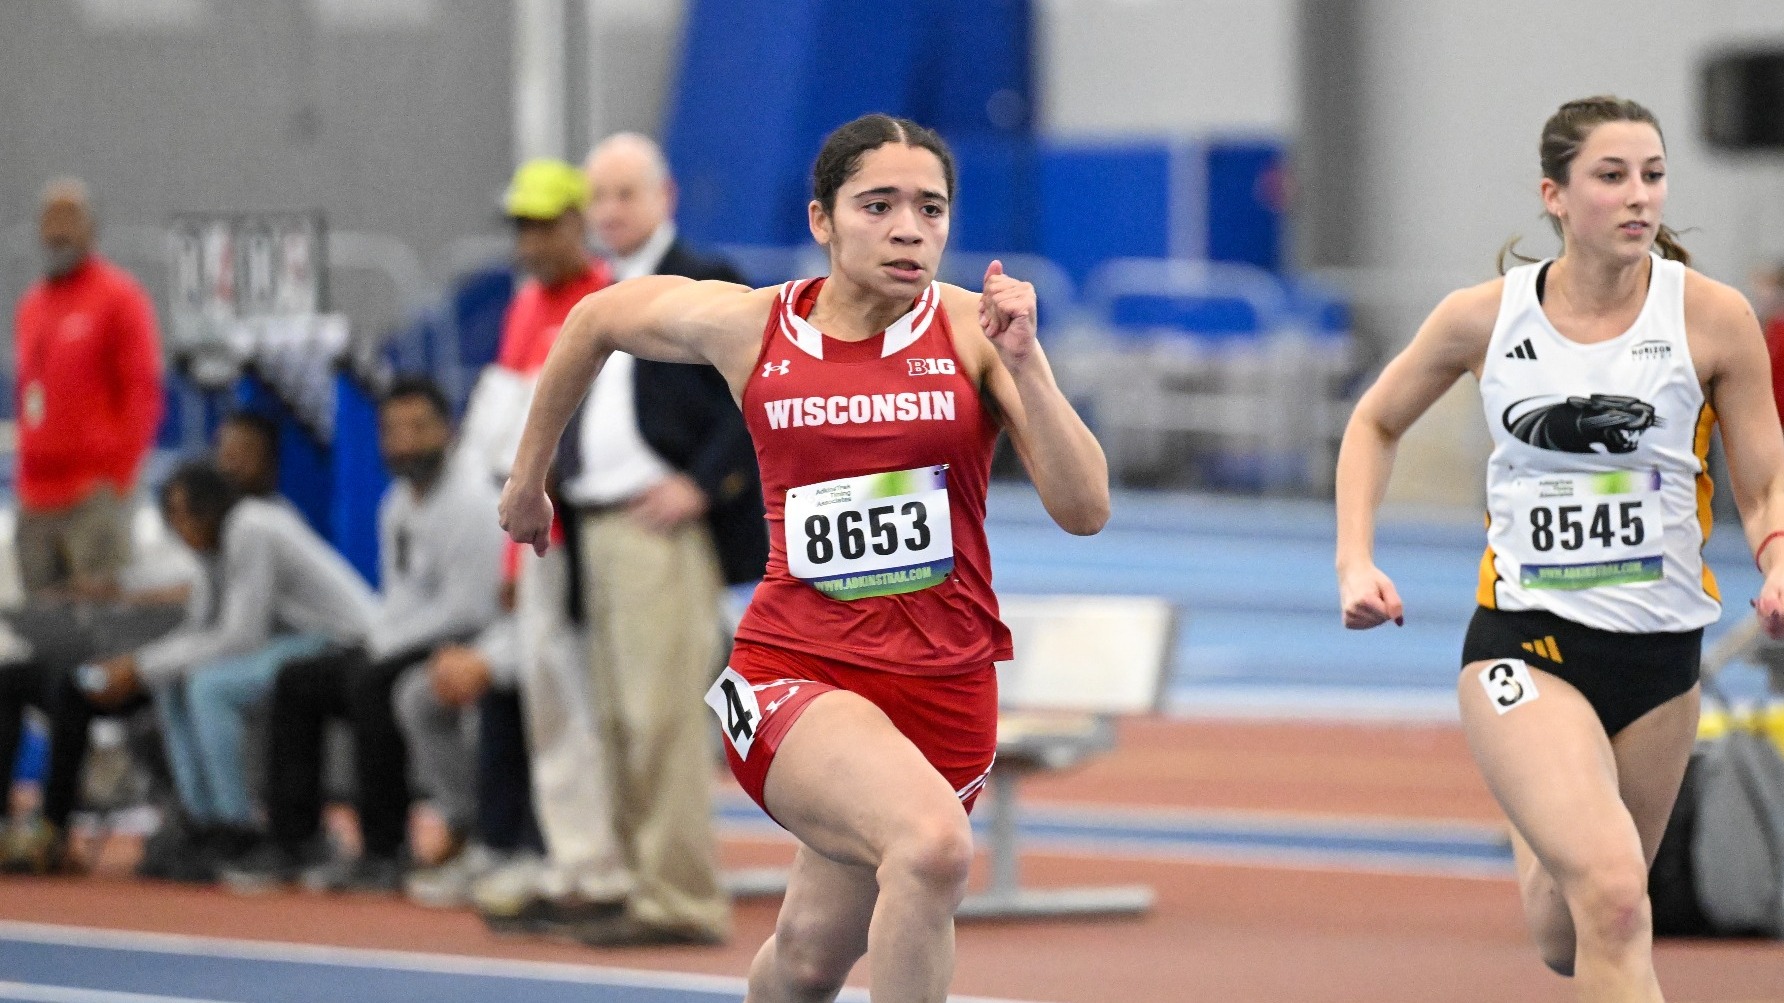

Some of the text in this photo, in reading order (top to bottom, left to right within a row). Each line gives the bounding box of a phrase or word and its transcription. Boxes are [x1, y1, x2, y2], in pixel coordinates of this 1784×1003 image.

[764, 391, 956, 430] WISCONSIN
[804, 501, 931, 565] 8653
[1530, 501, 1645, 552] 8545
[814, 566, 932, 592] WWW.ADKINSTRAK.COM
[1489, 664, 1524, 707] 3
[720, 678, 753, 742] 4
